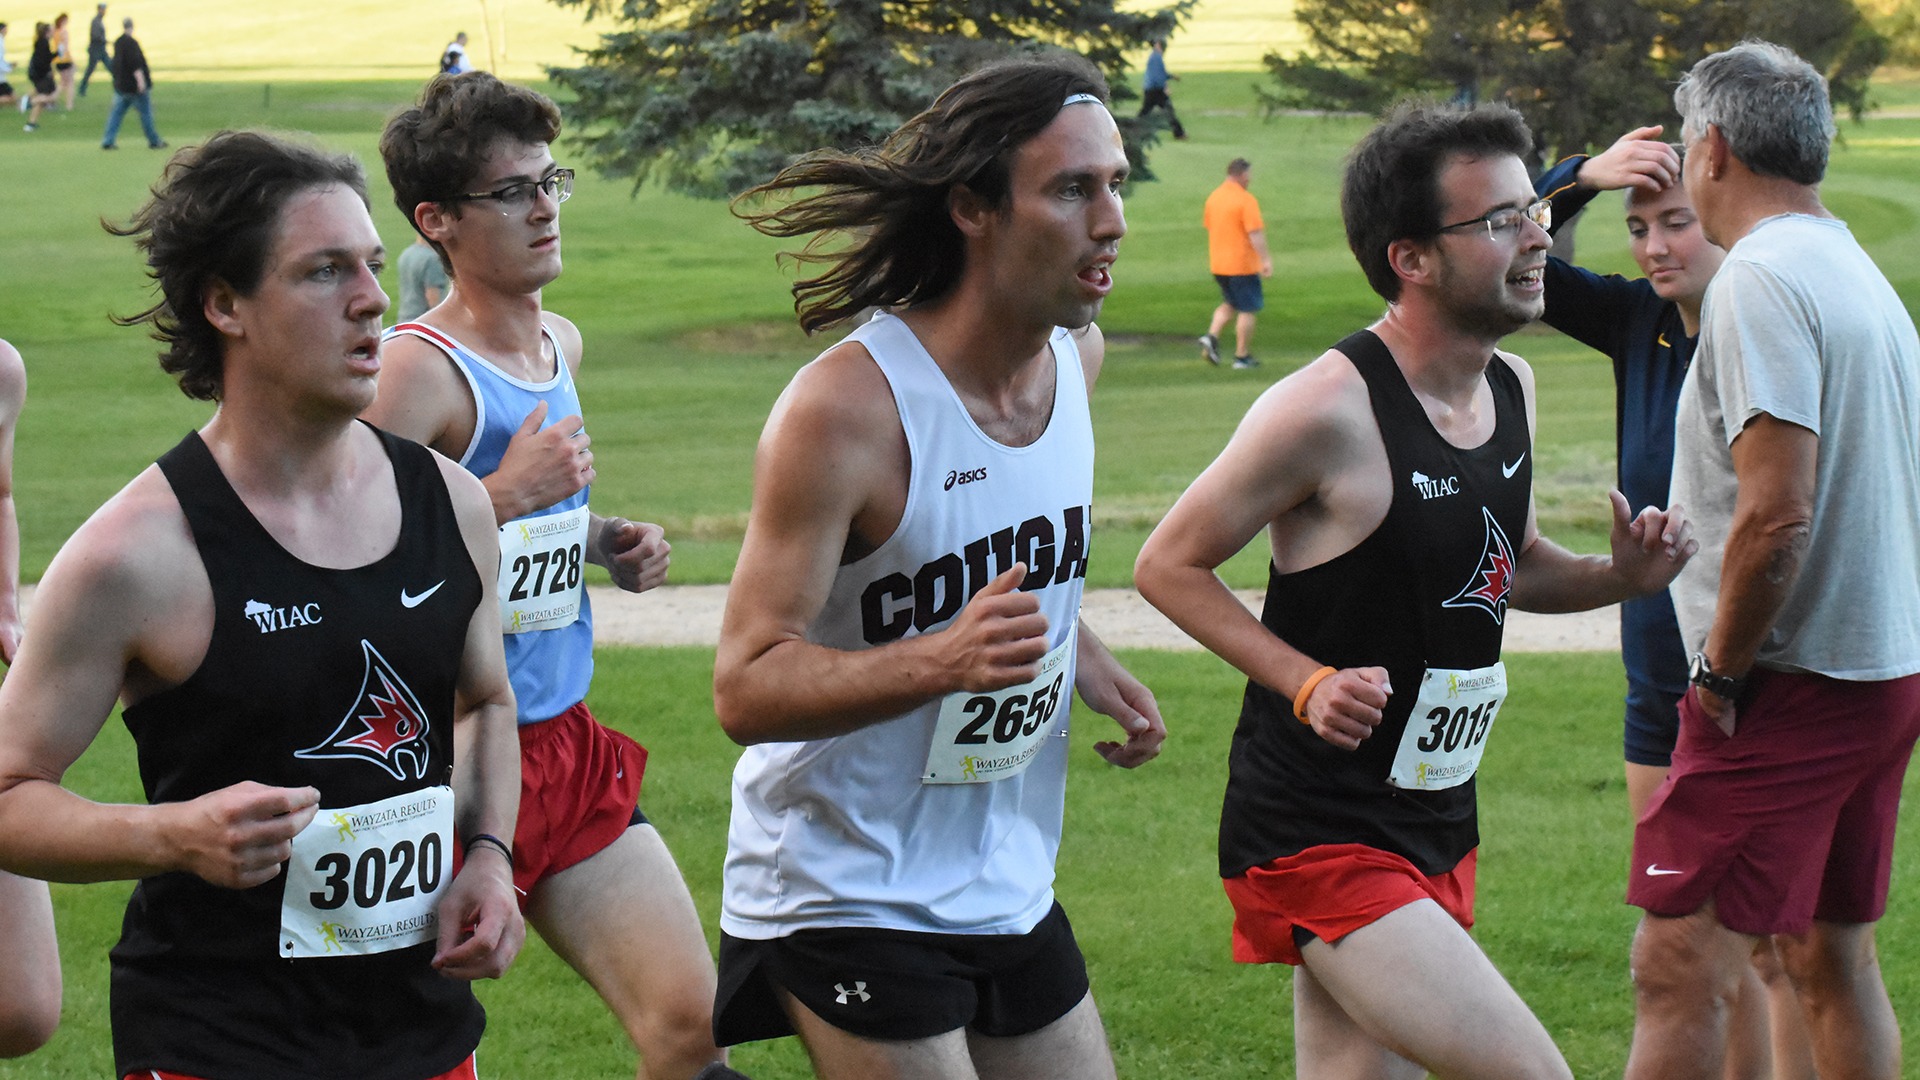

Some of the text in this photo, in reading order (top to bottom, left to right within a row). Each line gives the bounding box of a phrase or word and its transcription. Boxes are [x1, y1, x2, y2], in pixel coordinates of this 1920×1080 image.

[957, 467, 987, 485] asics
[1413, 476, 1460, 500] WIAC
[528, 523, 559, 536] WAYZATA
[558, 517, 581, 530] RESULTS
[508, 543, 581, 602] 2728
[860, 505, 1092, 645] COUGA
[247, 603, 323, 634] WIAC
[520, 609, 552, 622] WAYZATA
[954, 671, 1064, 745] 2658
[1417, 699, 1497, 753] 3015
[976, 754, 1020, 769] WAYZATA
[351, 808, 398, 827] WAYZATA
[400, 797, 437, 817] RESULTS
[310, 833, 442, 909] 3020
[338, 924, 393, 939] WAYZATA
[396, 911, 435, 932] RESULTS
